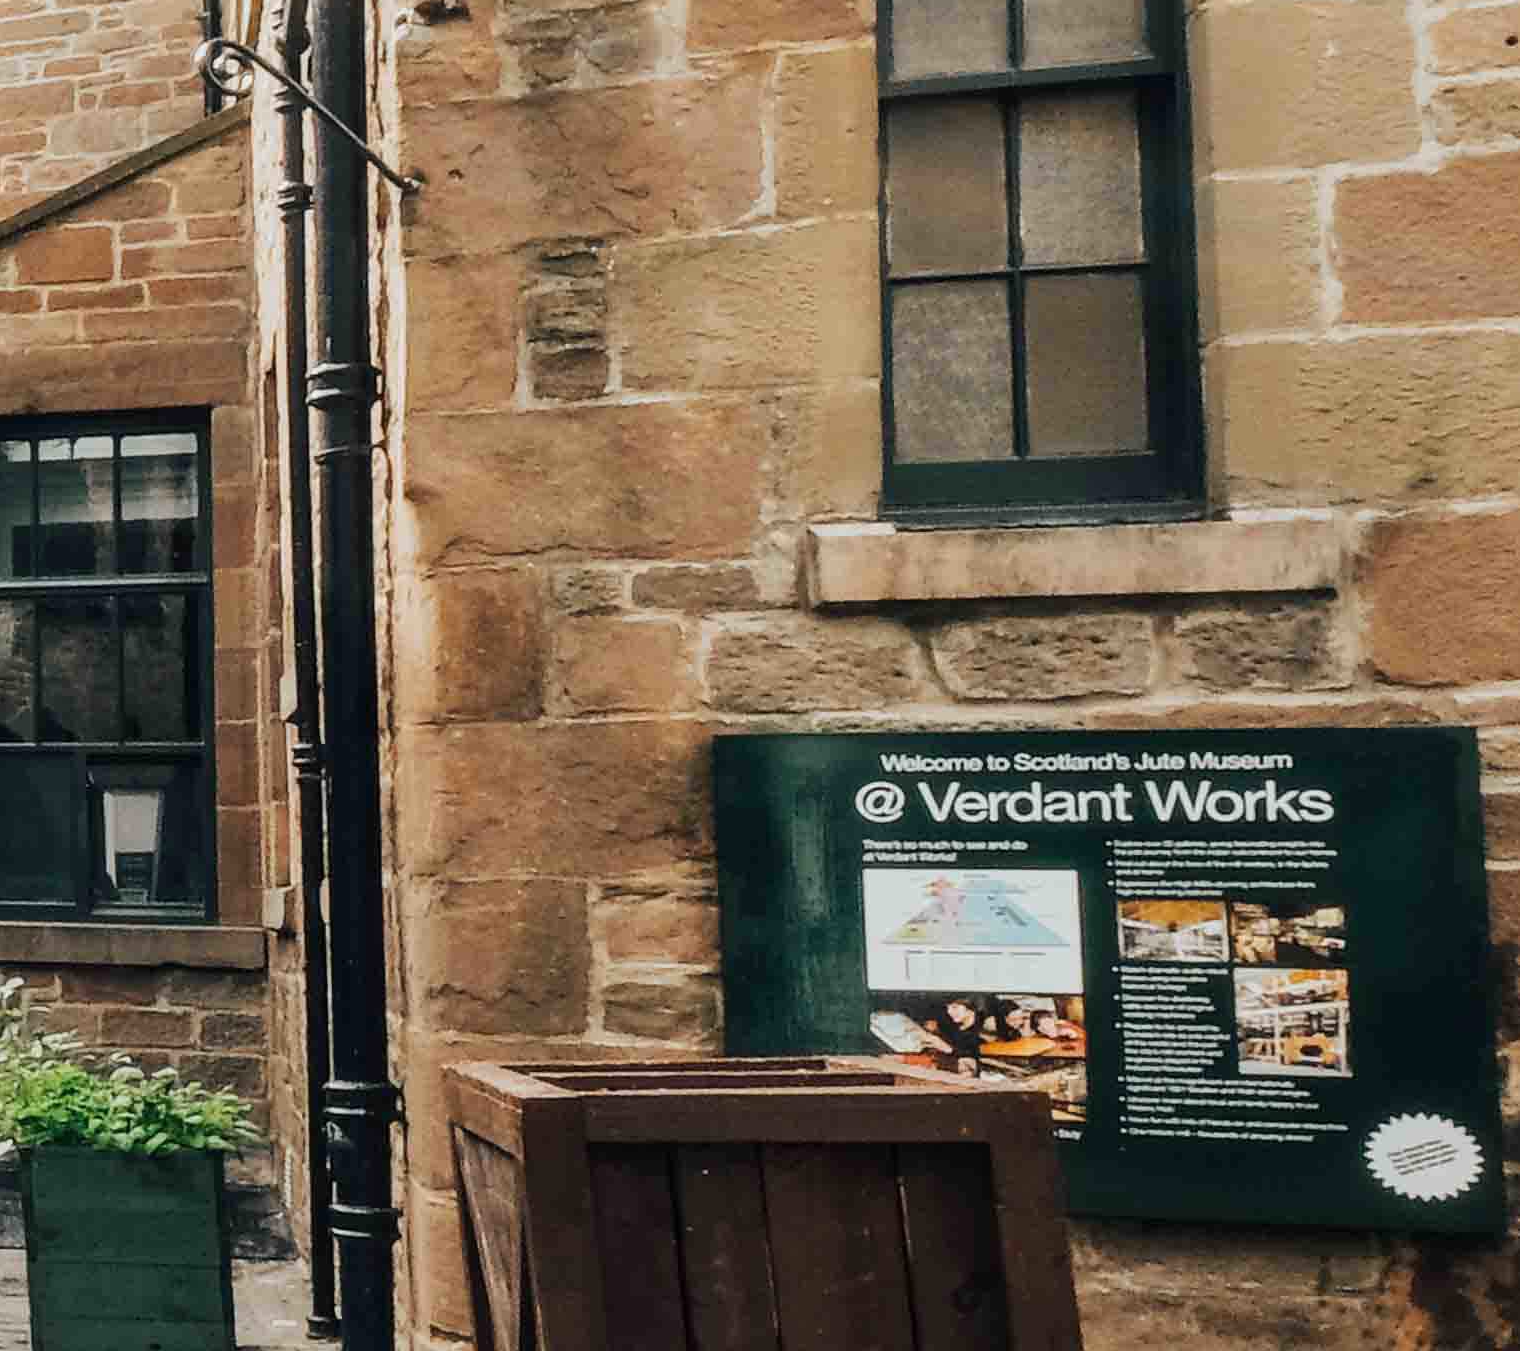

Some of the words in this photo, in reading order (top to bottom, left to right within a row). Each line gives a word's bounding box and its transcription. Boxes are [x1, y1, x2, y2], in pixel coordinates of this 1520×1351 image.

[880, 753, 984, 773] Welcome
[987, 753, 1011, 772] to
[1014, 752, 1131, 772] Scotland's
[1134, 752, 1186, 771] Jute
[1189, 751, 1294, 770] Museum
[855, 780, 906, 823] @
[916, 781, 1134, 823] Verdant
[1143, 779, 1335, 823] Works
